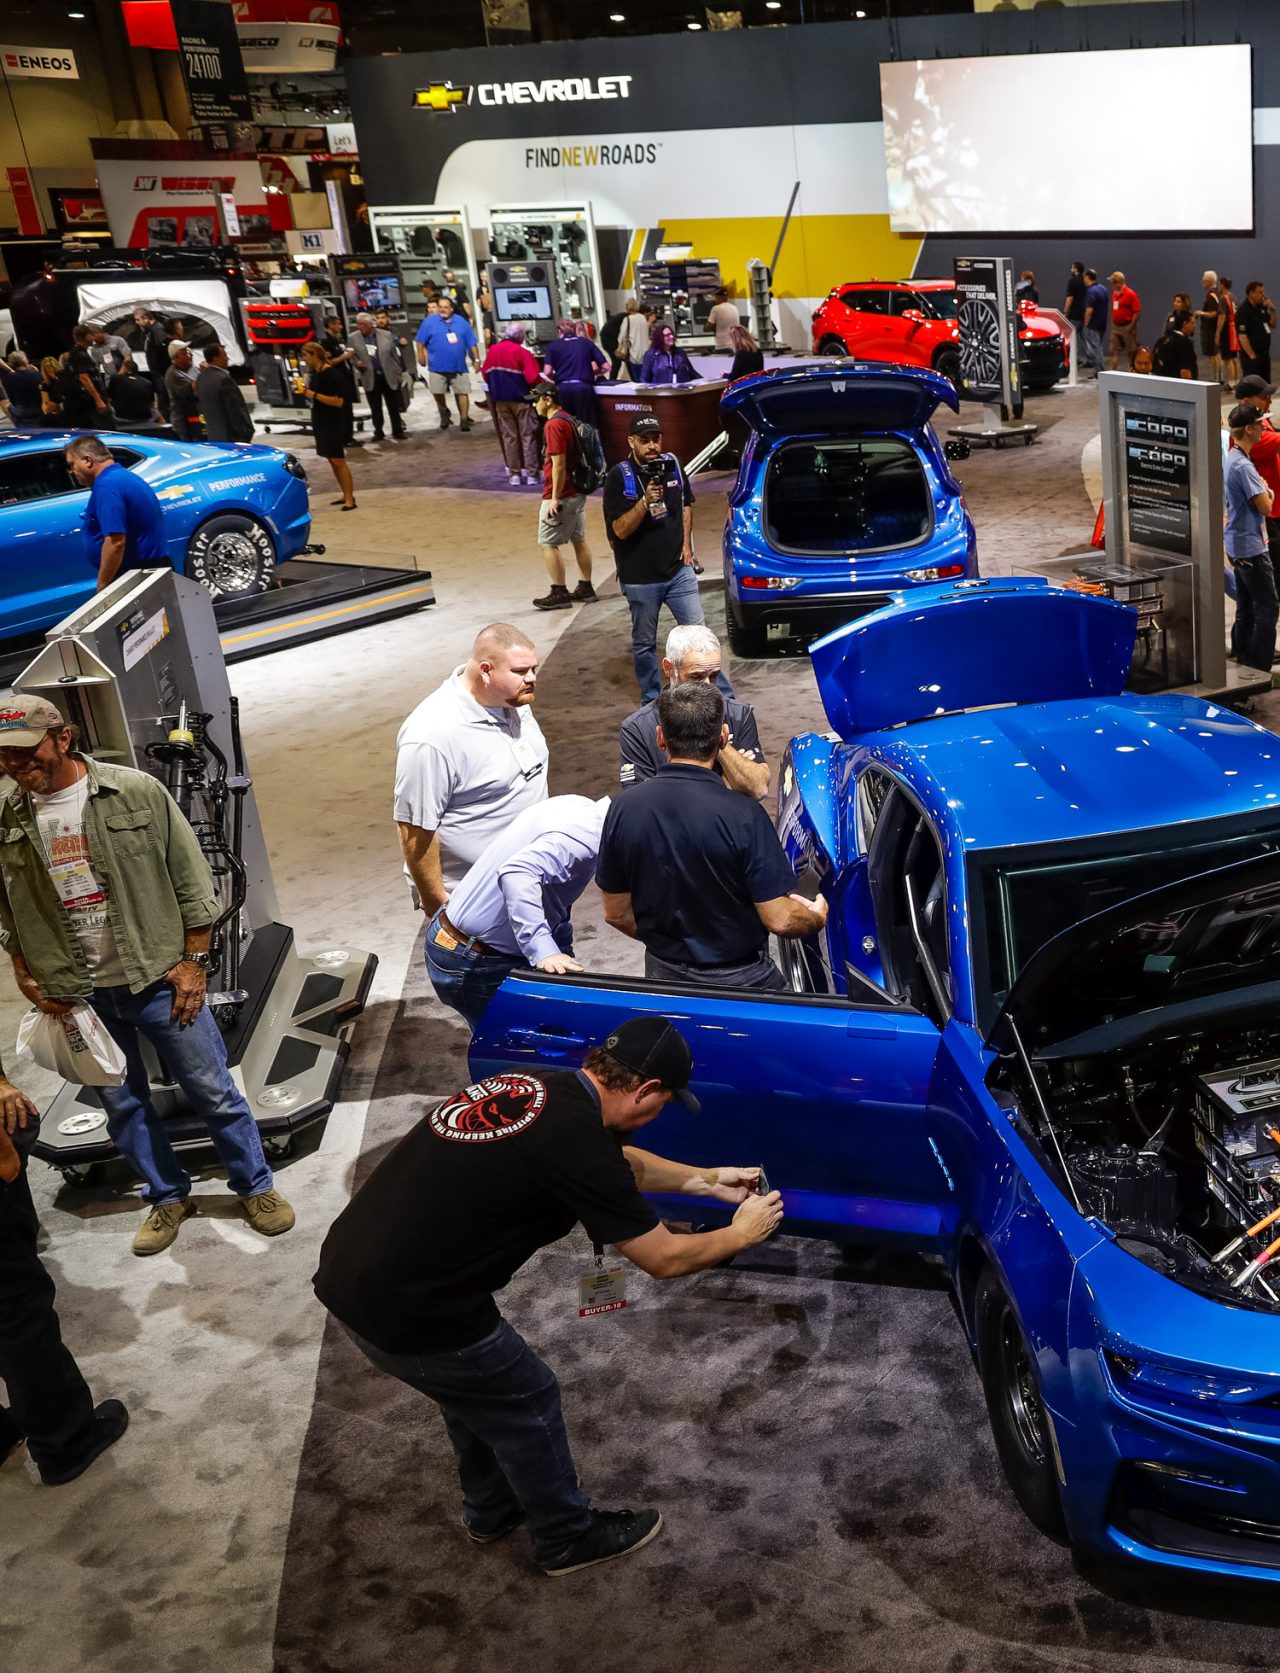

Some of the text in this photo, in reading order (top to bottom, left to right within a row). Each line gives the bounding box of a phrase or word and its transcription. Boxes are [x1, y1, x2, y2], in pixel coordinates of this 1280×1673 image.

[18, 55, 72, 71] ENEOS
[186, 53, 222, 80] 24100
[478, 75, 632, 106] CHEVROLET
[303, 233, 321, 247] K1
[956, 284, 986, 292] ACCESSORIES
[614, 403, 653, 412] INFORMATION
[208, 472, 268, 493] PERFORMANCE
[496, 1111, 536, 1137] SPITFIRE
[445, 1130, 495, 1141] KEEPING
